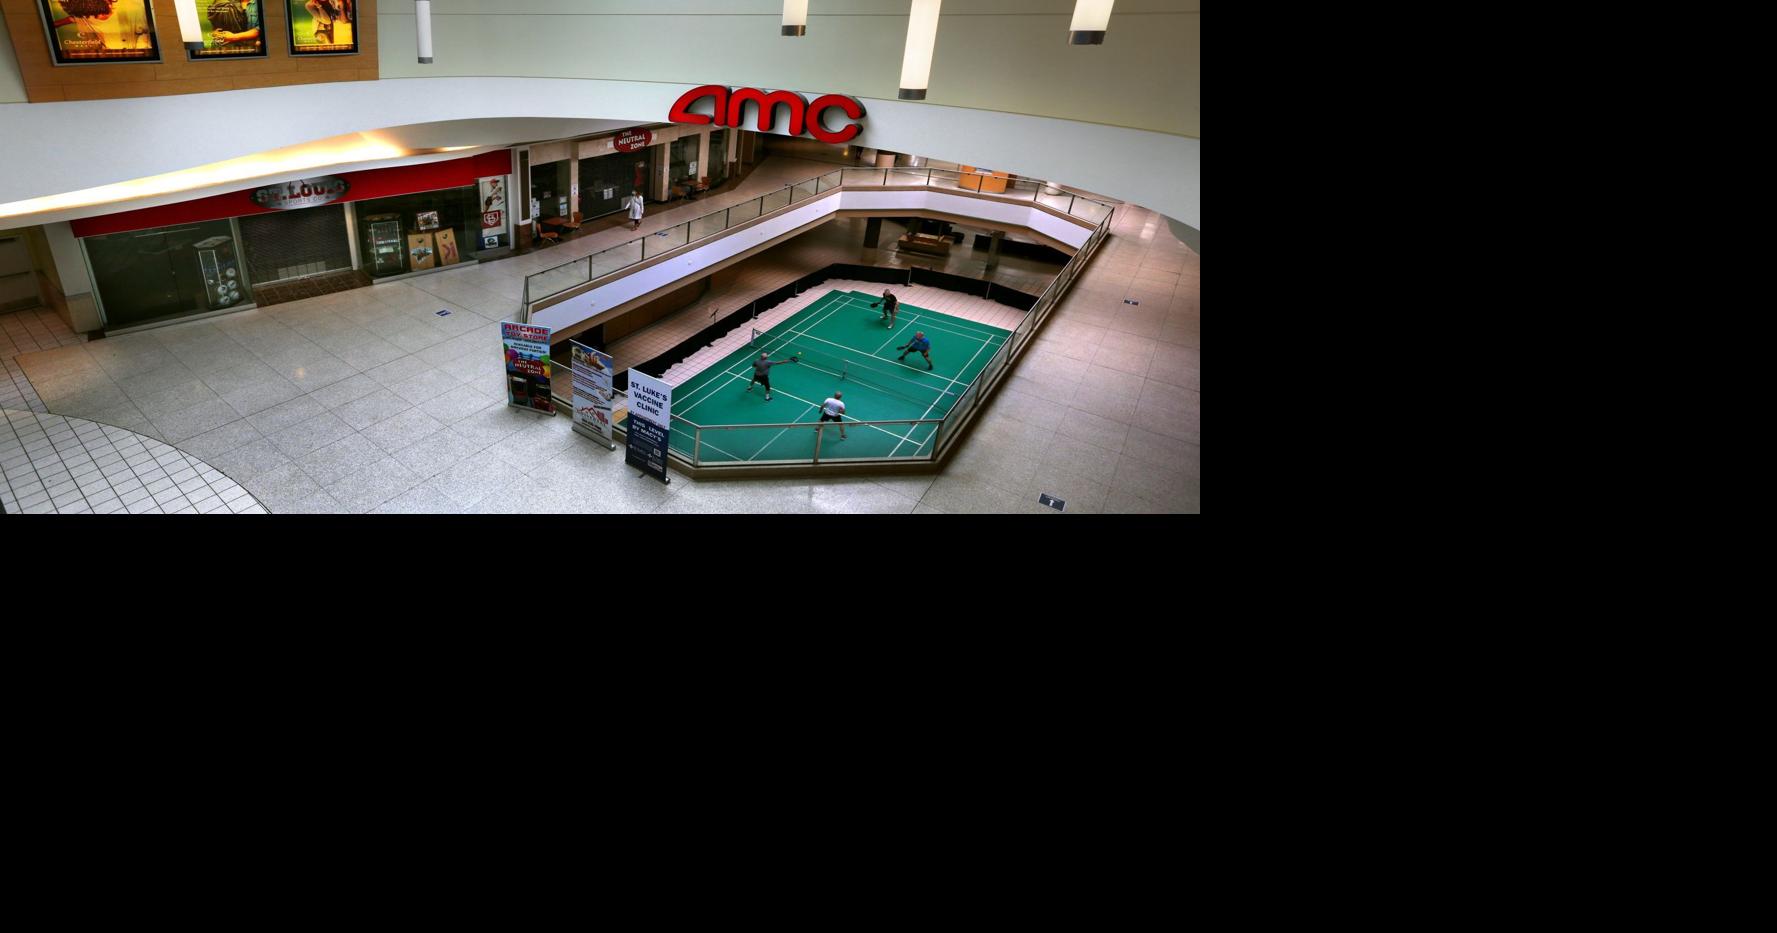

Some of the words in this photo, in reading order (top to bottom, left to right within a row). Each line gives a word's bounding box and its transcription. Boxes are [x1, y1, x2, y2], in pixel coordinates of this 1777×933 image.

[668, 84, 866, 144] amc
[618, 133, 646, 145] NEUTRAL
[630, 141, 645, 150] ZONE
[504, 323, 548, 334] ARCADE
[630, 381, 641, 391] ST.
[642, 386, 668, 402] LUKE'S
[633, 391, 664, 409] VACCINE
[636, 401, 660, 417] CLINIC
[640, 428, 662, 442] MACY'S
[648, 426, 665, 438] LEVEL
